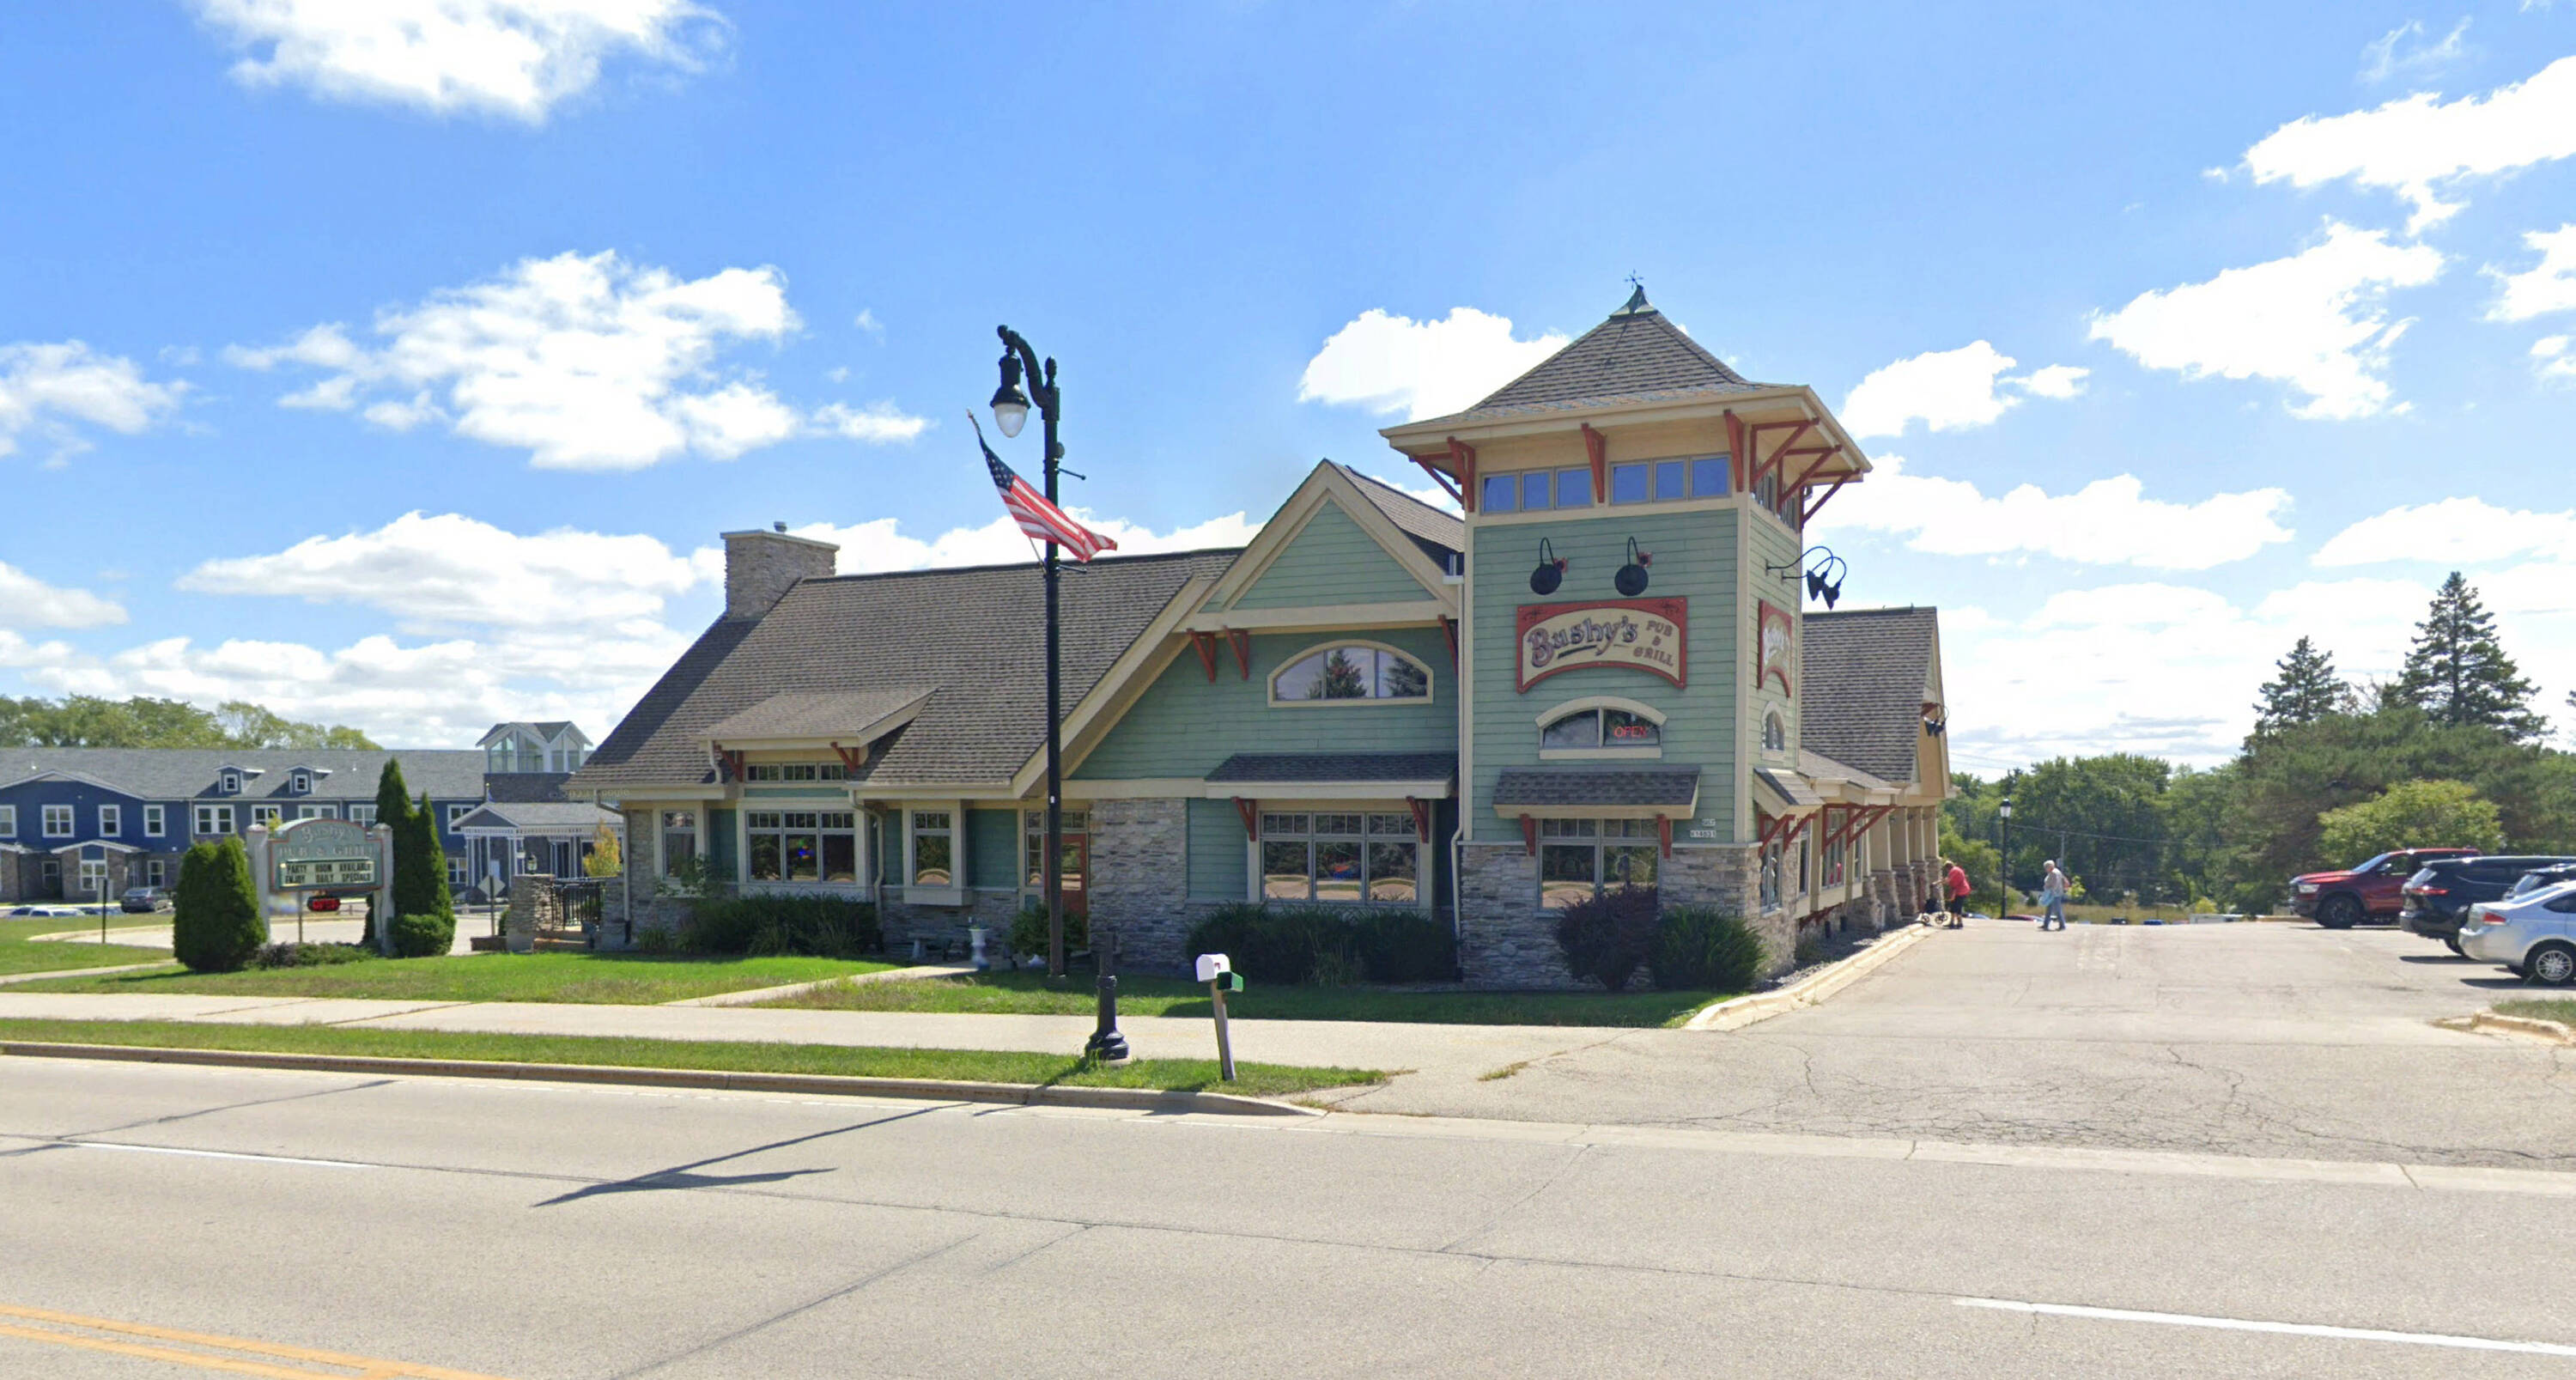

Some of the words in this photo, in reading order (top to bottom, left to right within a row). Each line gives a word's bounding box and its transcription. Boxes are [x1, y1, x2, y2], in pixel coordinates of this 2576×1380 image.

[1646, 620, 1674, 636] PUB
[1528, 616, 1638, 667] Bushy's
[1652, 635, 1662, 647] &
[1633, 646, 1674, 667] GRILL
[1614, 726, 1647, 738] OPEN
[280, 846, 307, 857] PUB
[287, 864, 307, 873] PARTY
